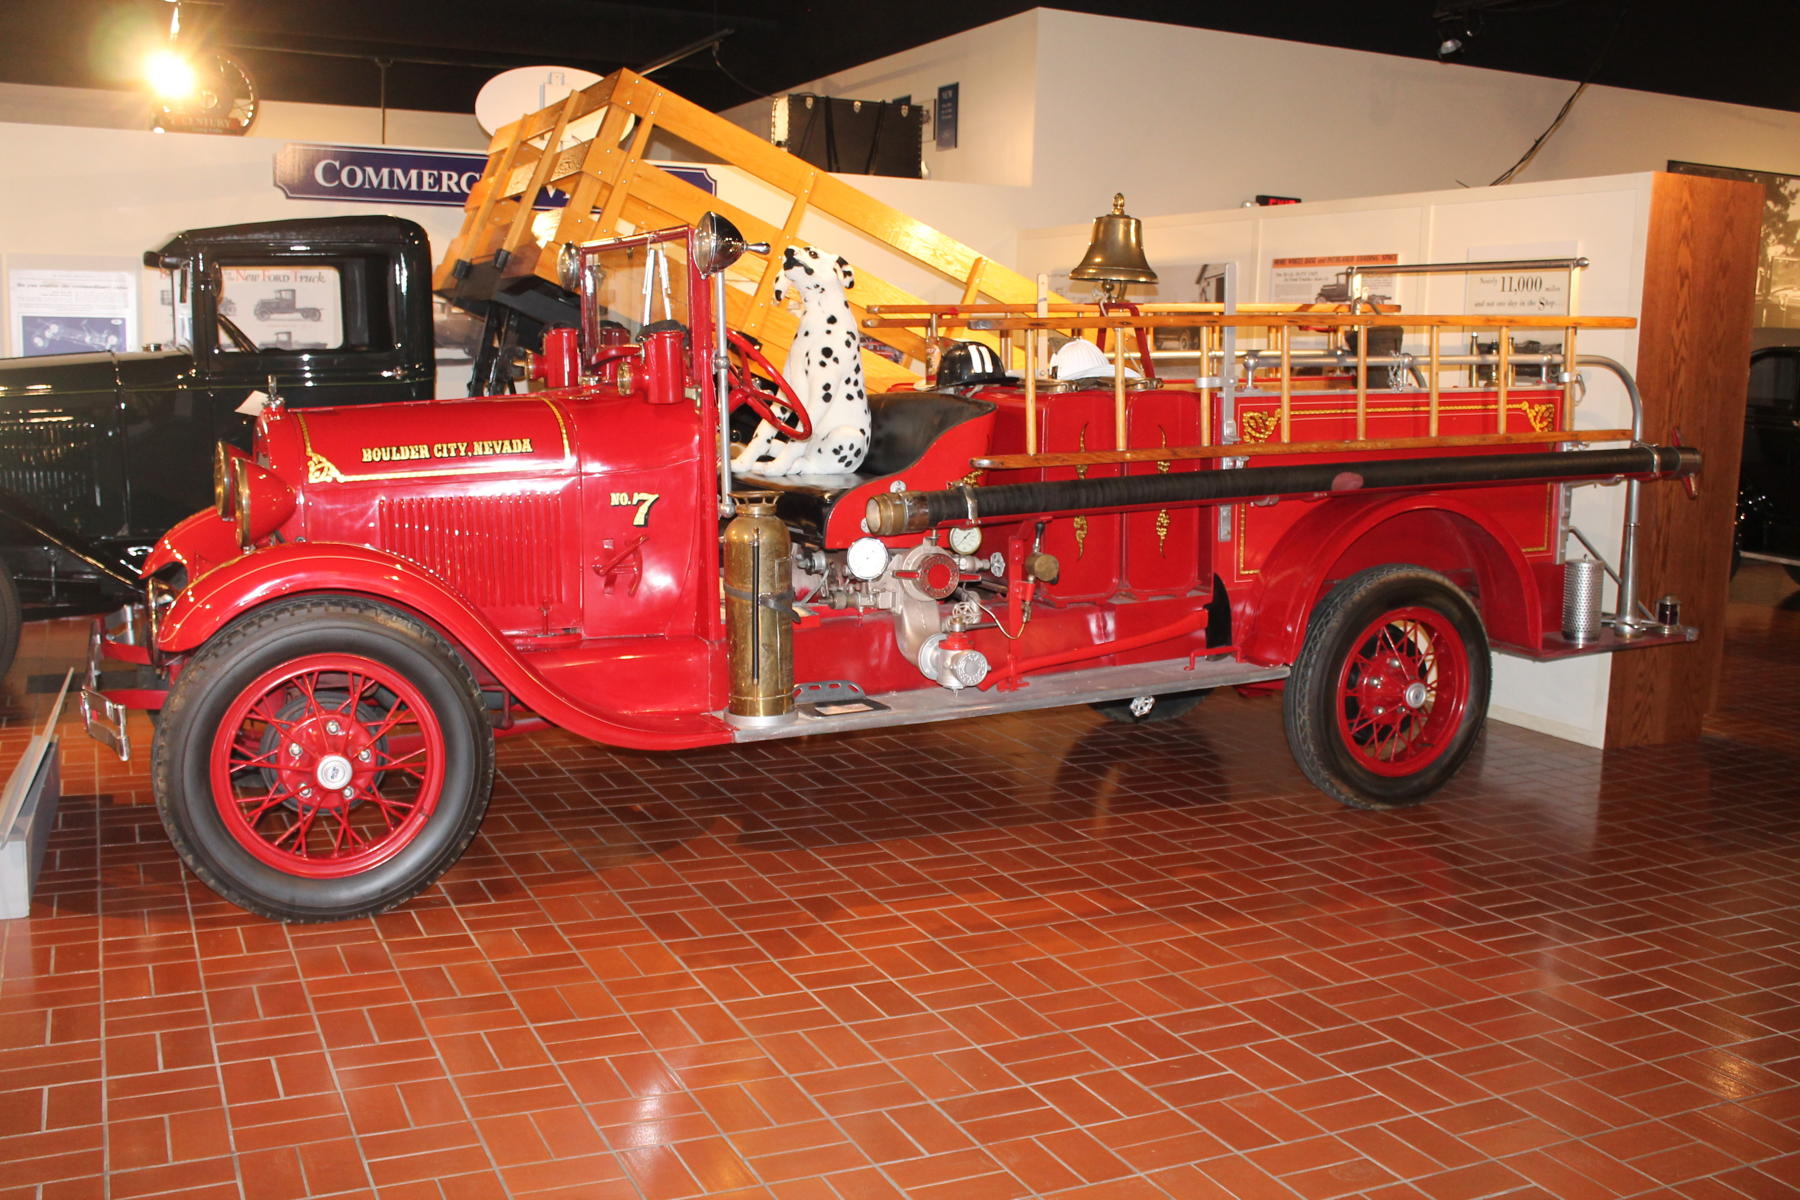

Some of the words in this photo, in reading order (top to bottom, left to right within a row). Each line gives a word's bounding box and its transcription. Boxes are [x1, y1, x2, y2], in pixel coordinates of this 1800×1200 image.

[313, 159, 483, 195] COMMERC
[1501, 276, 1543, 294] 11,000
[362, 444, 431, 462] BOULDER
[433, 442, 472, 458] CITY,
[473, 438, 534, 456] NEVADA
[610, 492, 631, 506] NO.
[632, 492, 660, 528] 7
